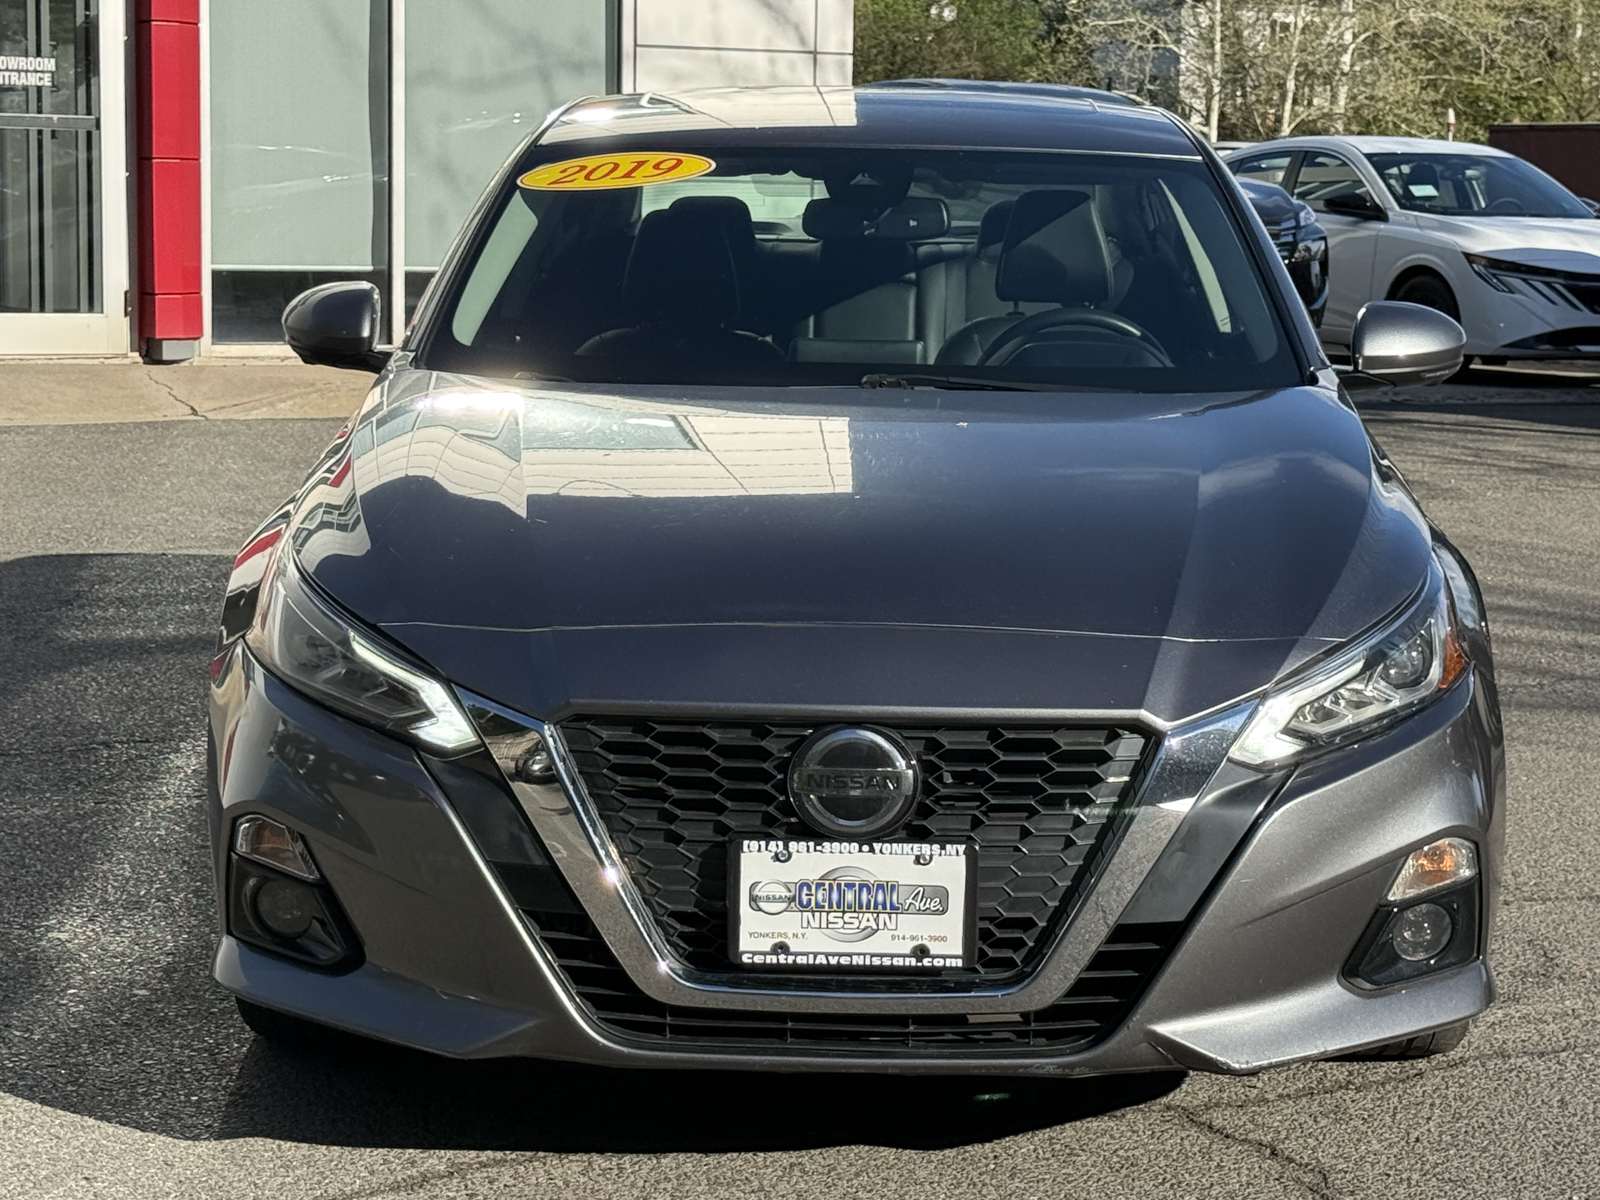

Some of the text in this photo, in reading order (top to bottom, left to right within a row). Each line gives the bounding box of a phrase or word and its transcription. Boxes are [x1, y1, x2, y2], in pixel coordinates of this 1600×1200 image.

[546, 157, 684, 187] 2019
[806, 772, 900, 791] NISSAN
[788, 841, 860, 854] 961-3900
[796, 879, 944, 912] CENTRAL Ave.
[801, 911, 898, 930] NISSAN
[748, 931, 808, 941] YONKERS, N.Y.
[890, 933, 948, 943] 914-961-3900
[741, 952, 963, 967] CentralAveNissan.com
